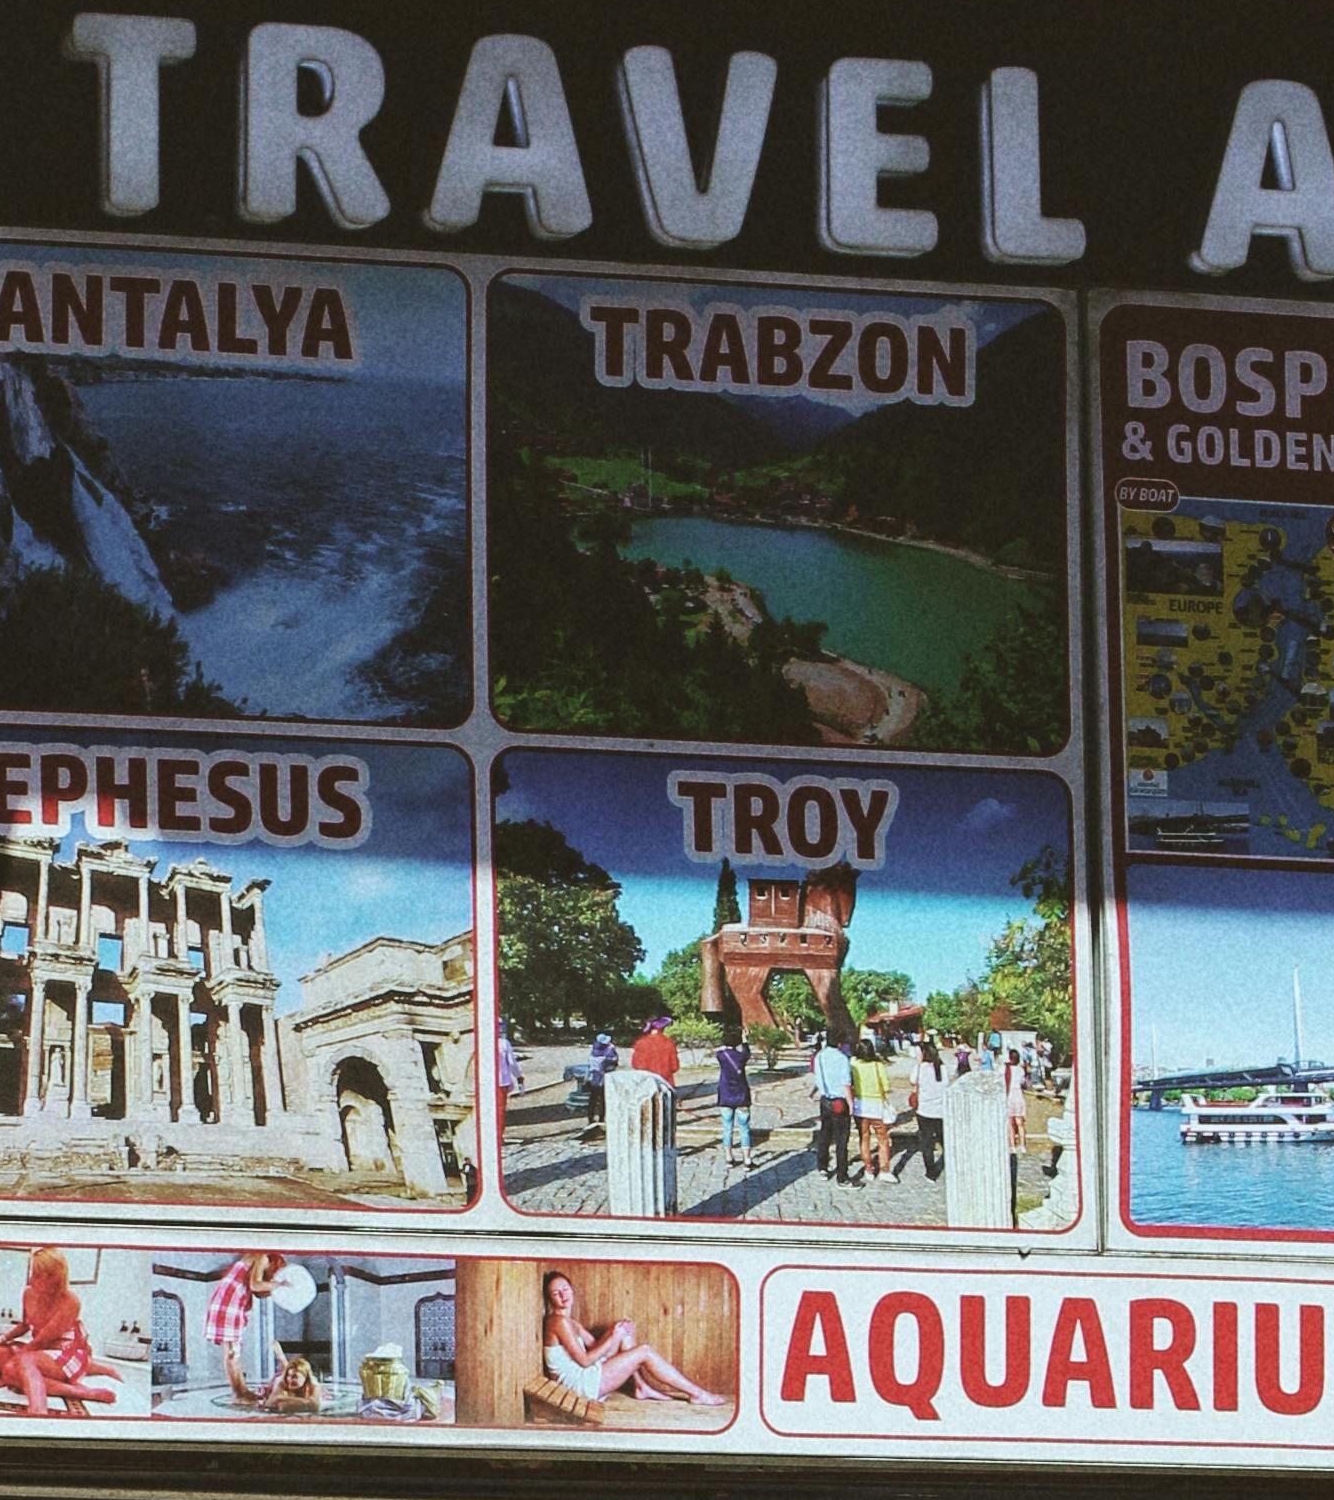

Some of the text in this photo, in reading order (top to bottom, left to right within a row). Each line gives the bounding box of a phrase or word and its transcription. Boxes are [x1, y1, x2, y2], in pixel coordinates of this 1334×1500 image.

[64, 12, 1087, 266] TRAVEL
[590, 306, 966, 398] TRABZON
[1122, 422, 1154, 462] &
[677, 780, 889, 859] TROY
